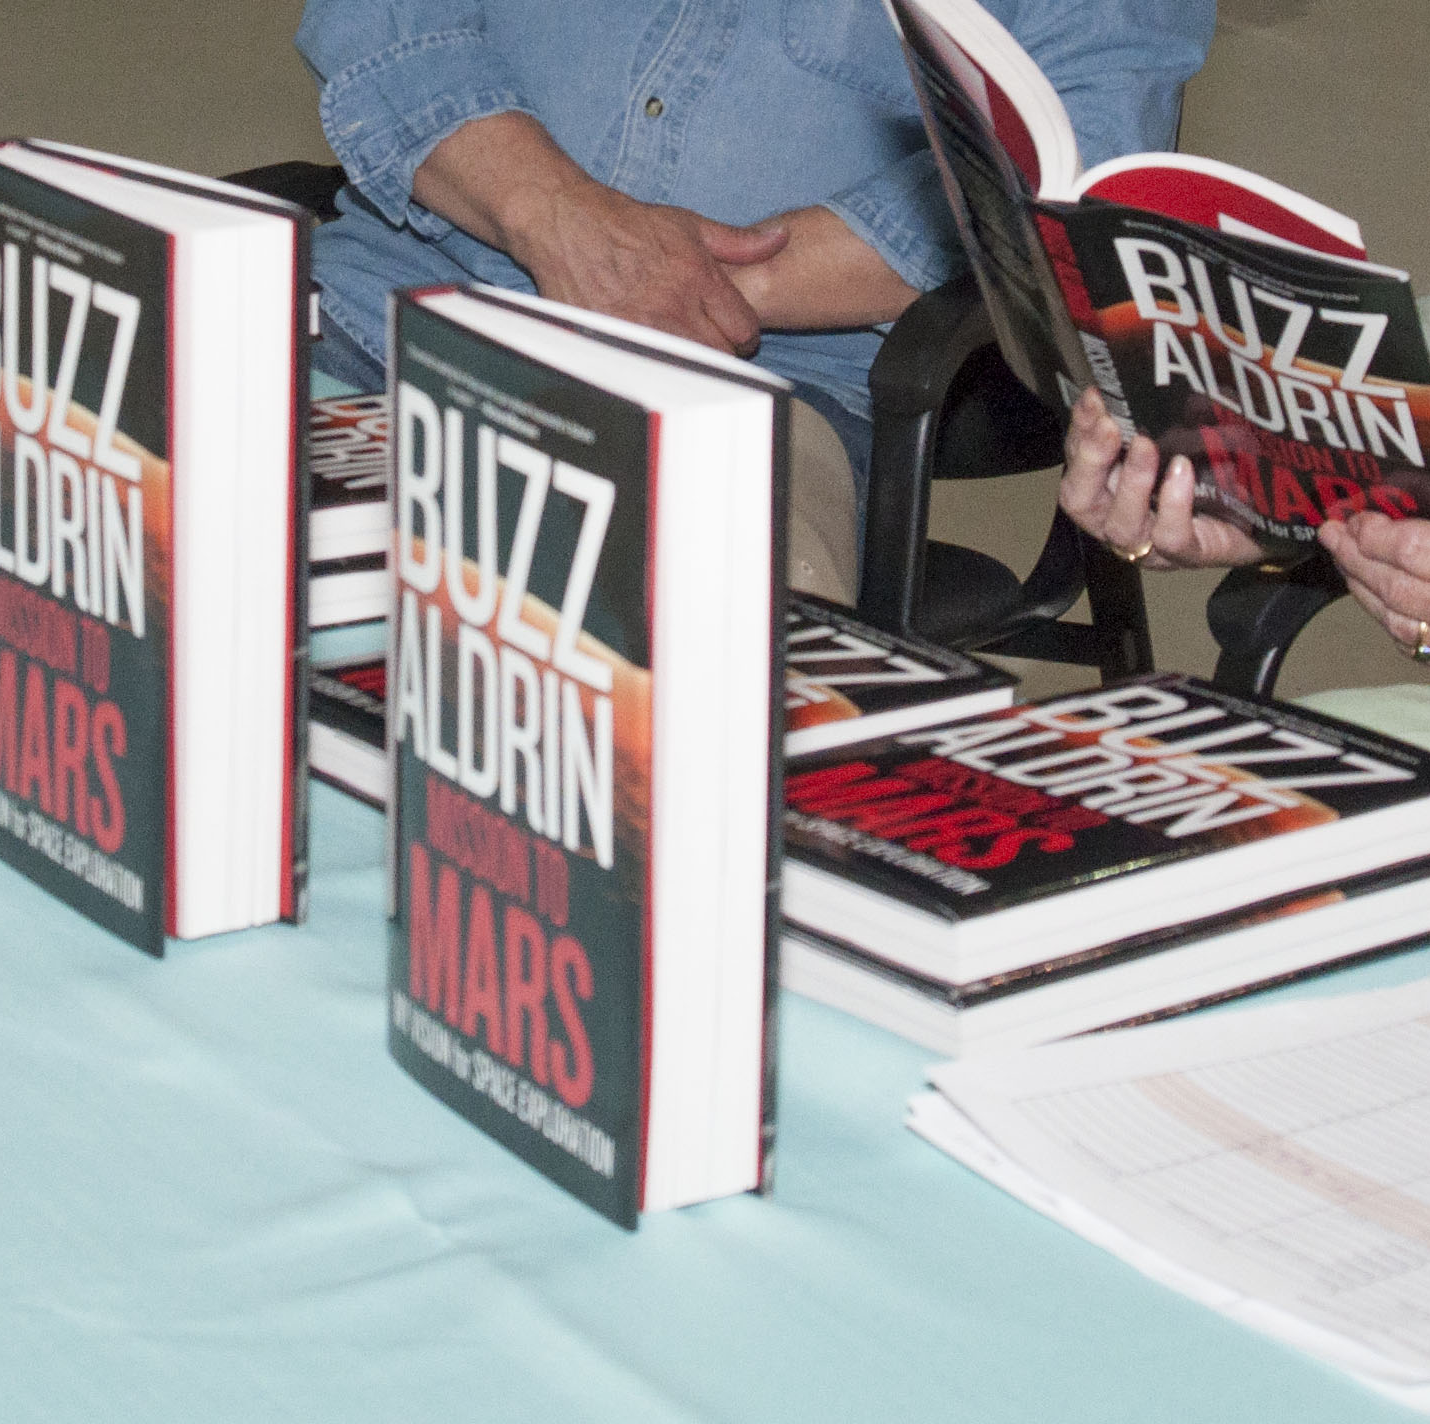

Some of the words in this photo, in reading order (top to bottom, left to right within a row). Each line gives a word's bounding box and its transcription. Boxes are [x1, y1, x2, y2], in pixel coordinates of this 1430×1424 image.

[1114, 236, 1409, 400] BUZZ
[1153, 320, 1425, 469] ALDRIN
[396, 380, 617, 693] BUZZ
[396, 586, 615, 870] ALDRIN
[894, 717, 1280, 839] ALDRIN
[1017, 684, 1417, 809] BUZZ
[408, 840, 596, 1110] MARS
